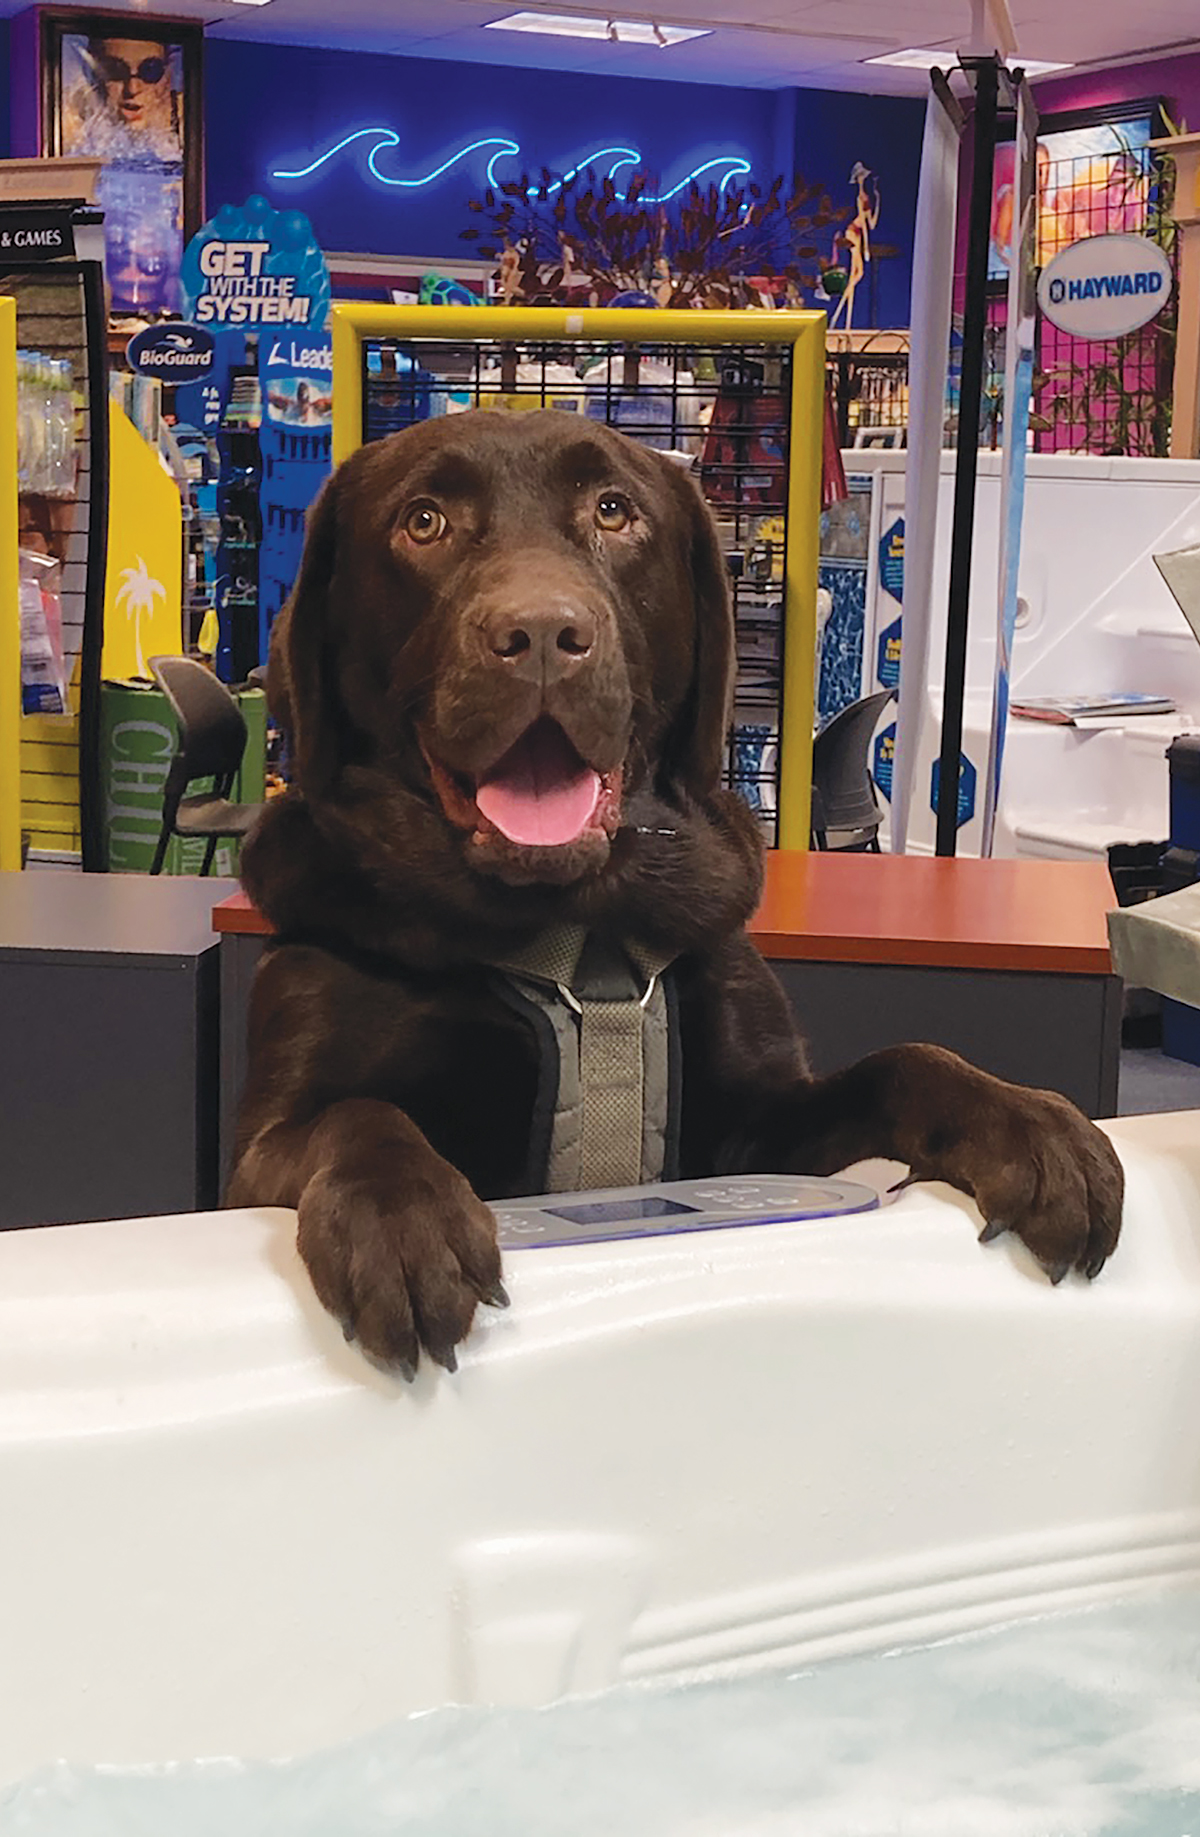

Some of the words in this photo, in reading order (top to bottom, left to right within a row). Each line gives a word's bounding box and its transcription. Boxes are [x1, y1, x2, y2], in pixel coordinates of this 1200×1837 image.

[1, 231, 11, 247] &
[14, 229, 62, 247] GAMES
[200, 241, 270, 276] GET
[210, 276, 258, 297] WITH
[259, 277, 296, 298] THE
[1068, 271, 1163, 301] HAYWARD
[196, 295, 310, 323] SYSTEM!
[139, 349, 213, 367] BioGuard
